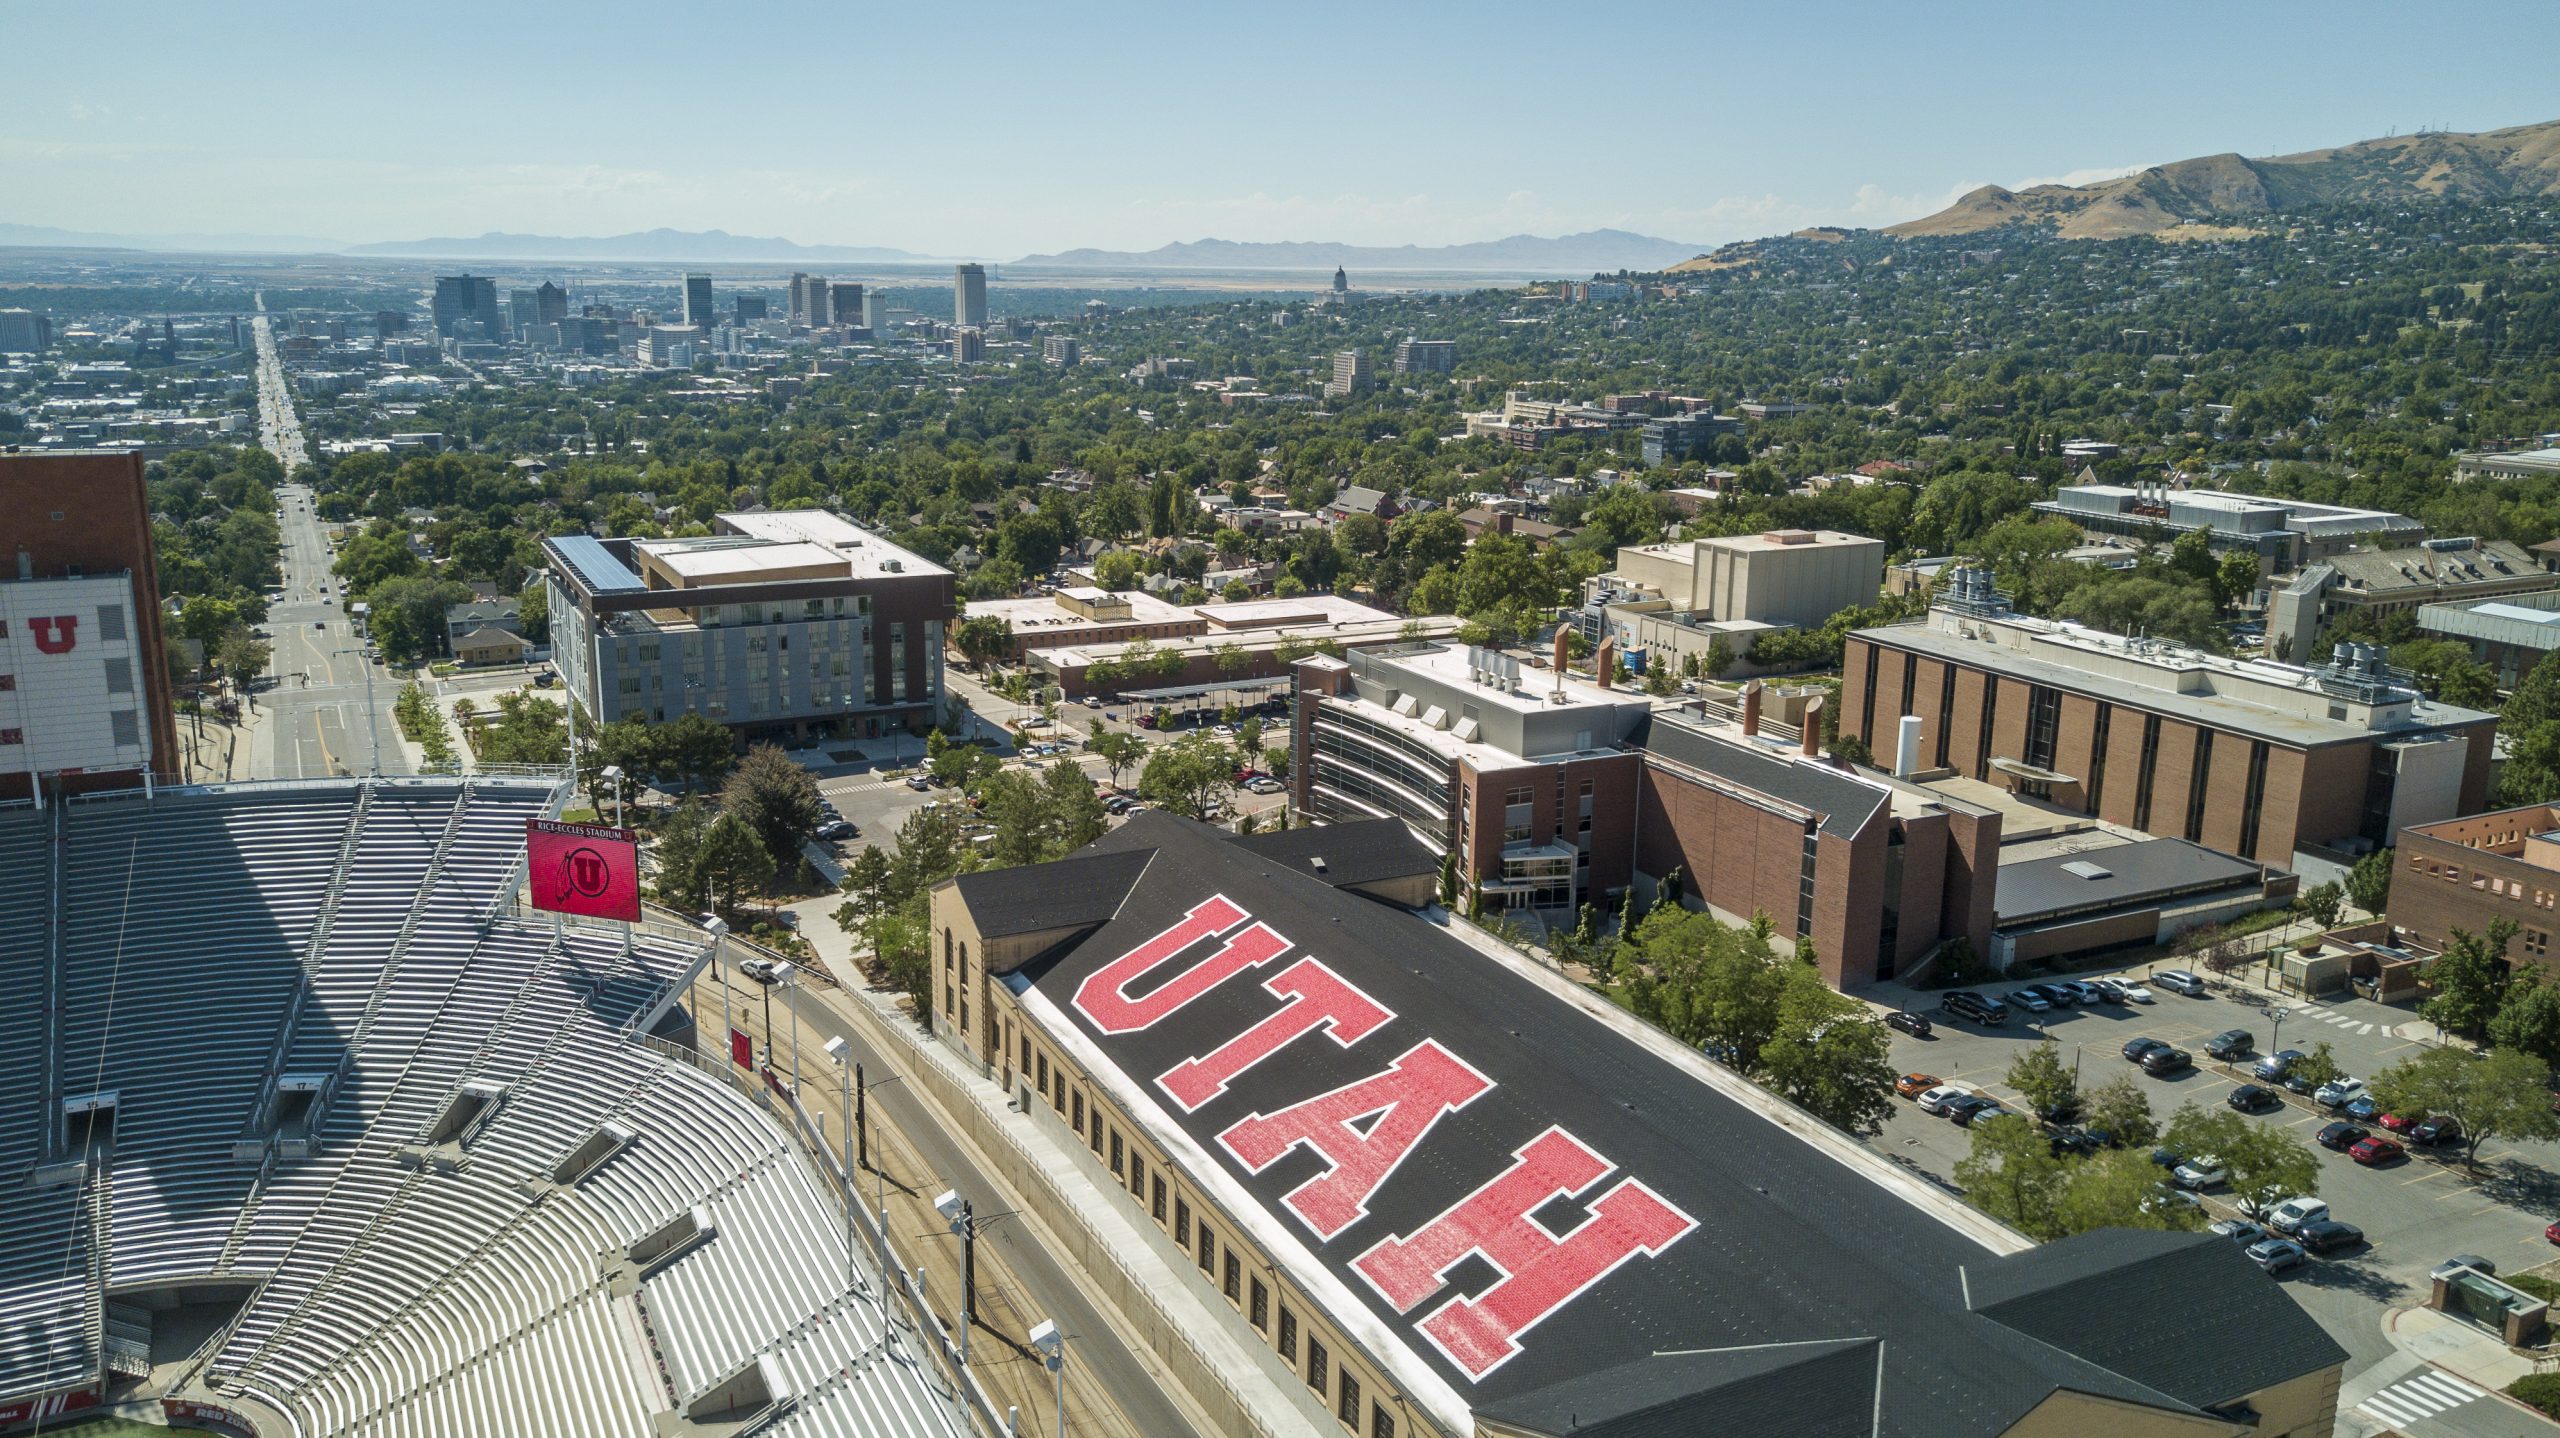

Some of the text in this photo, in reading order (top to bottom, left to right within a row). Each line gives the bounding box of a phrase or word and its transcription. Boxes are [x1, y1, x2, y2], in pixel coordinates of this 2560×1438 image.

[28, 615, 78, 655] U
[538, 822, 584, 835] RICE-ECCLES
[586, 829, 622, 839] STADIUM
[574, 857, 602, 892] U
[296, 1082, 307, 1090] 17
[1072, 893, 1701, 1384] UTAH
[195, 1408, 225, 1421] RED
